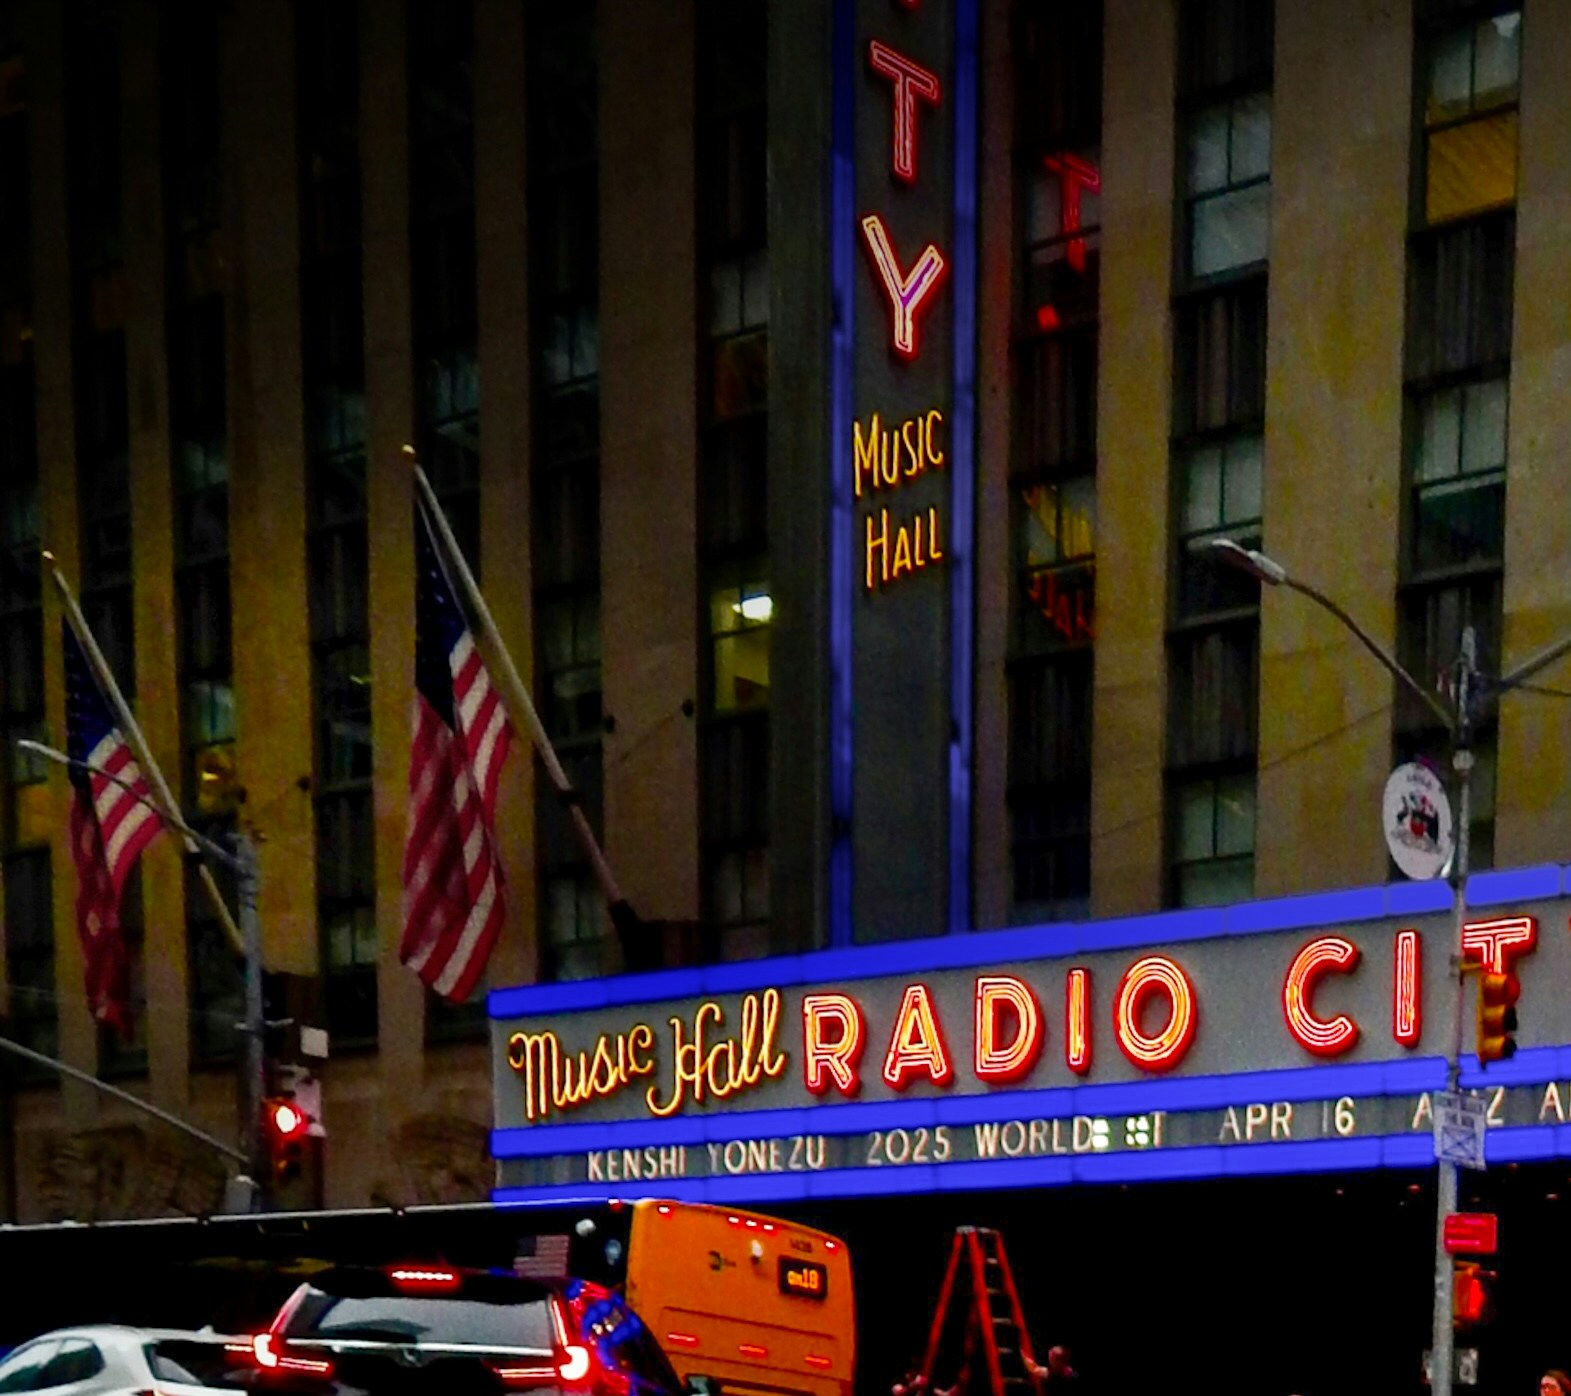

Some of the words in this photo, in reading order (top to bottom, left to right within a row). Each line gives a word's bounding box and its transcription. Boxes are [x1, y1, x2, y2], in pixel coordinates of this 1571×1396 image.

[861, 0, 944, 360] TY
[853, 409, 944, 497] MUSIC
[866, 507, 943, 589] HALL
[508, 1023, 655, 1119] Music
[646, 987, 786, 1117] Hall
[802, 954, 1197, 1096] RADIO
[587, 1146, 688, 1182] KENSHI
[707, 1137, 827, 1173] YONEZU
[867, 1126, 951, 1164] 2025
[975, 1114, 1093, 1158] WORLD
[1219, 1101, 1293, 1141] APR
[1321, 1097, 1356, 1137] 16
[1411, 1086, 1504, 1129] AZ
